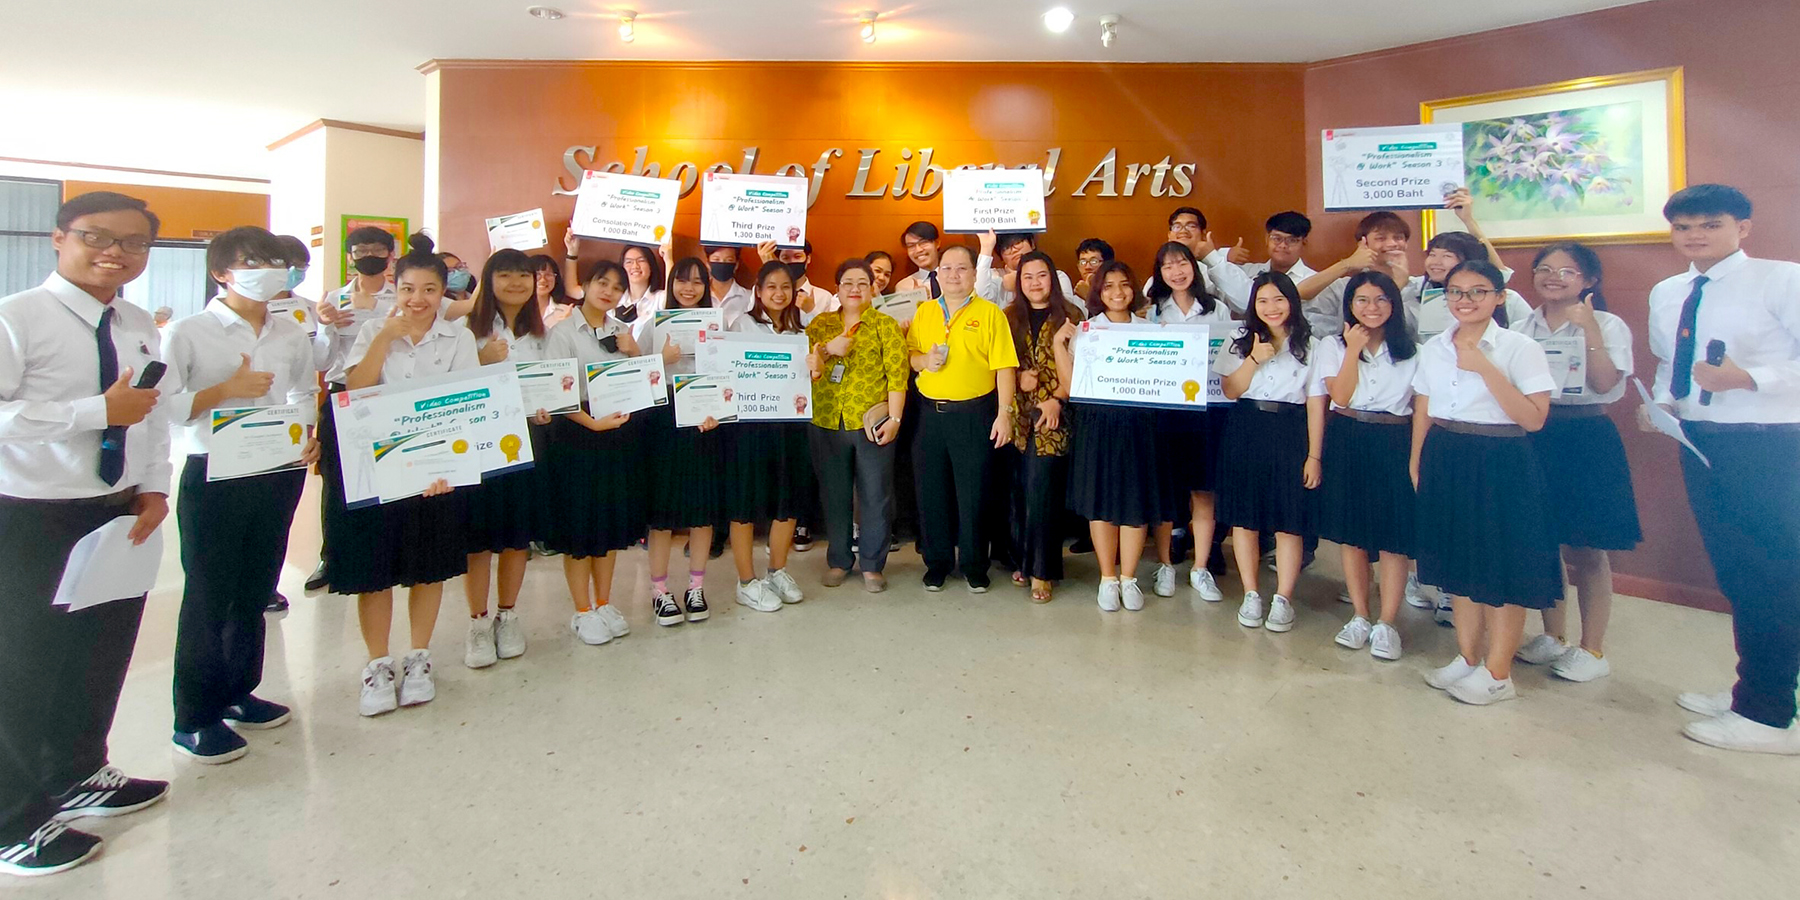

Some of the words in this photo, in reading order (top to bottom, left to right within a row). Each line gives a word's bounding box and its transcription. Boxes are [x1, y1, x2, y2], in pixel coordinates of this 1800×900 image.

[1401, 161, 1432, 169] Season
[1435, 160, 1443, 168] 3
[1071, 146, 1197, 199] Arts
[1355, 176, 1398, 188] Second
[1401, 177, 1431, 186] Prize
[1363, 189, 1394, 200] 3,000
[1397, 188, 1424, 198] Baht
[973, 207, 992, 215] First
[993, 207, 1015, 215] Prize
[592, 216, 633, 227] Consolation
[633, 221, 651, 230] Prize
[972, 216, 996, 224] 5,000
[997, 216, 1017, 224] Baht
[731, 221, 753, 230] Third
[602, 226, 621, 235] 1,000
[621, 228, 638, 237] Baht
[733, 230, 753, 239] 1,300
[755, 232, 772, 240] Baht
[731, 360, 789, 370] "Professionalism
[1148, 357, 1177, 366] Season
[1180, 358, 1188, 366] 3
[764, 371, 788, 380] Season
[790, 372, 797, 380] 3
[1097, 375, 1151, 386] Consolation
[1153, 377, 1177, 387] Prize
[1111, 386, 1136, 395] 1,000
[1138, 386, 1161, 396] Baht
[420, 400, 442, 409] Video
[444, 391, 487, 405] Competition
[760, 393, 781, 402] Prize
[736, 404, 758, 413] 1,300
[759, 404, 778, 413] Baht
[394, 402, 486, 426] "Professionalism
[491, 410, 500, 420] 3
[426, 425, 463, 438] CERTIFICATE
